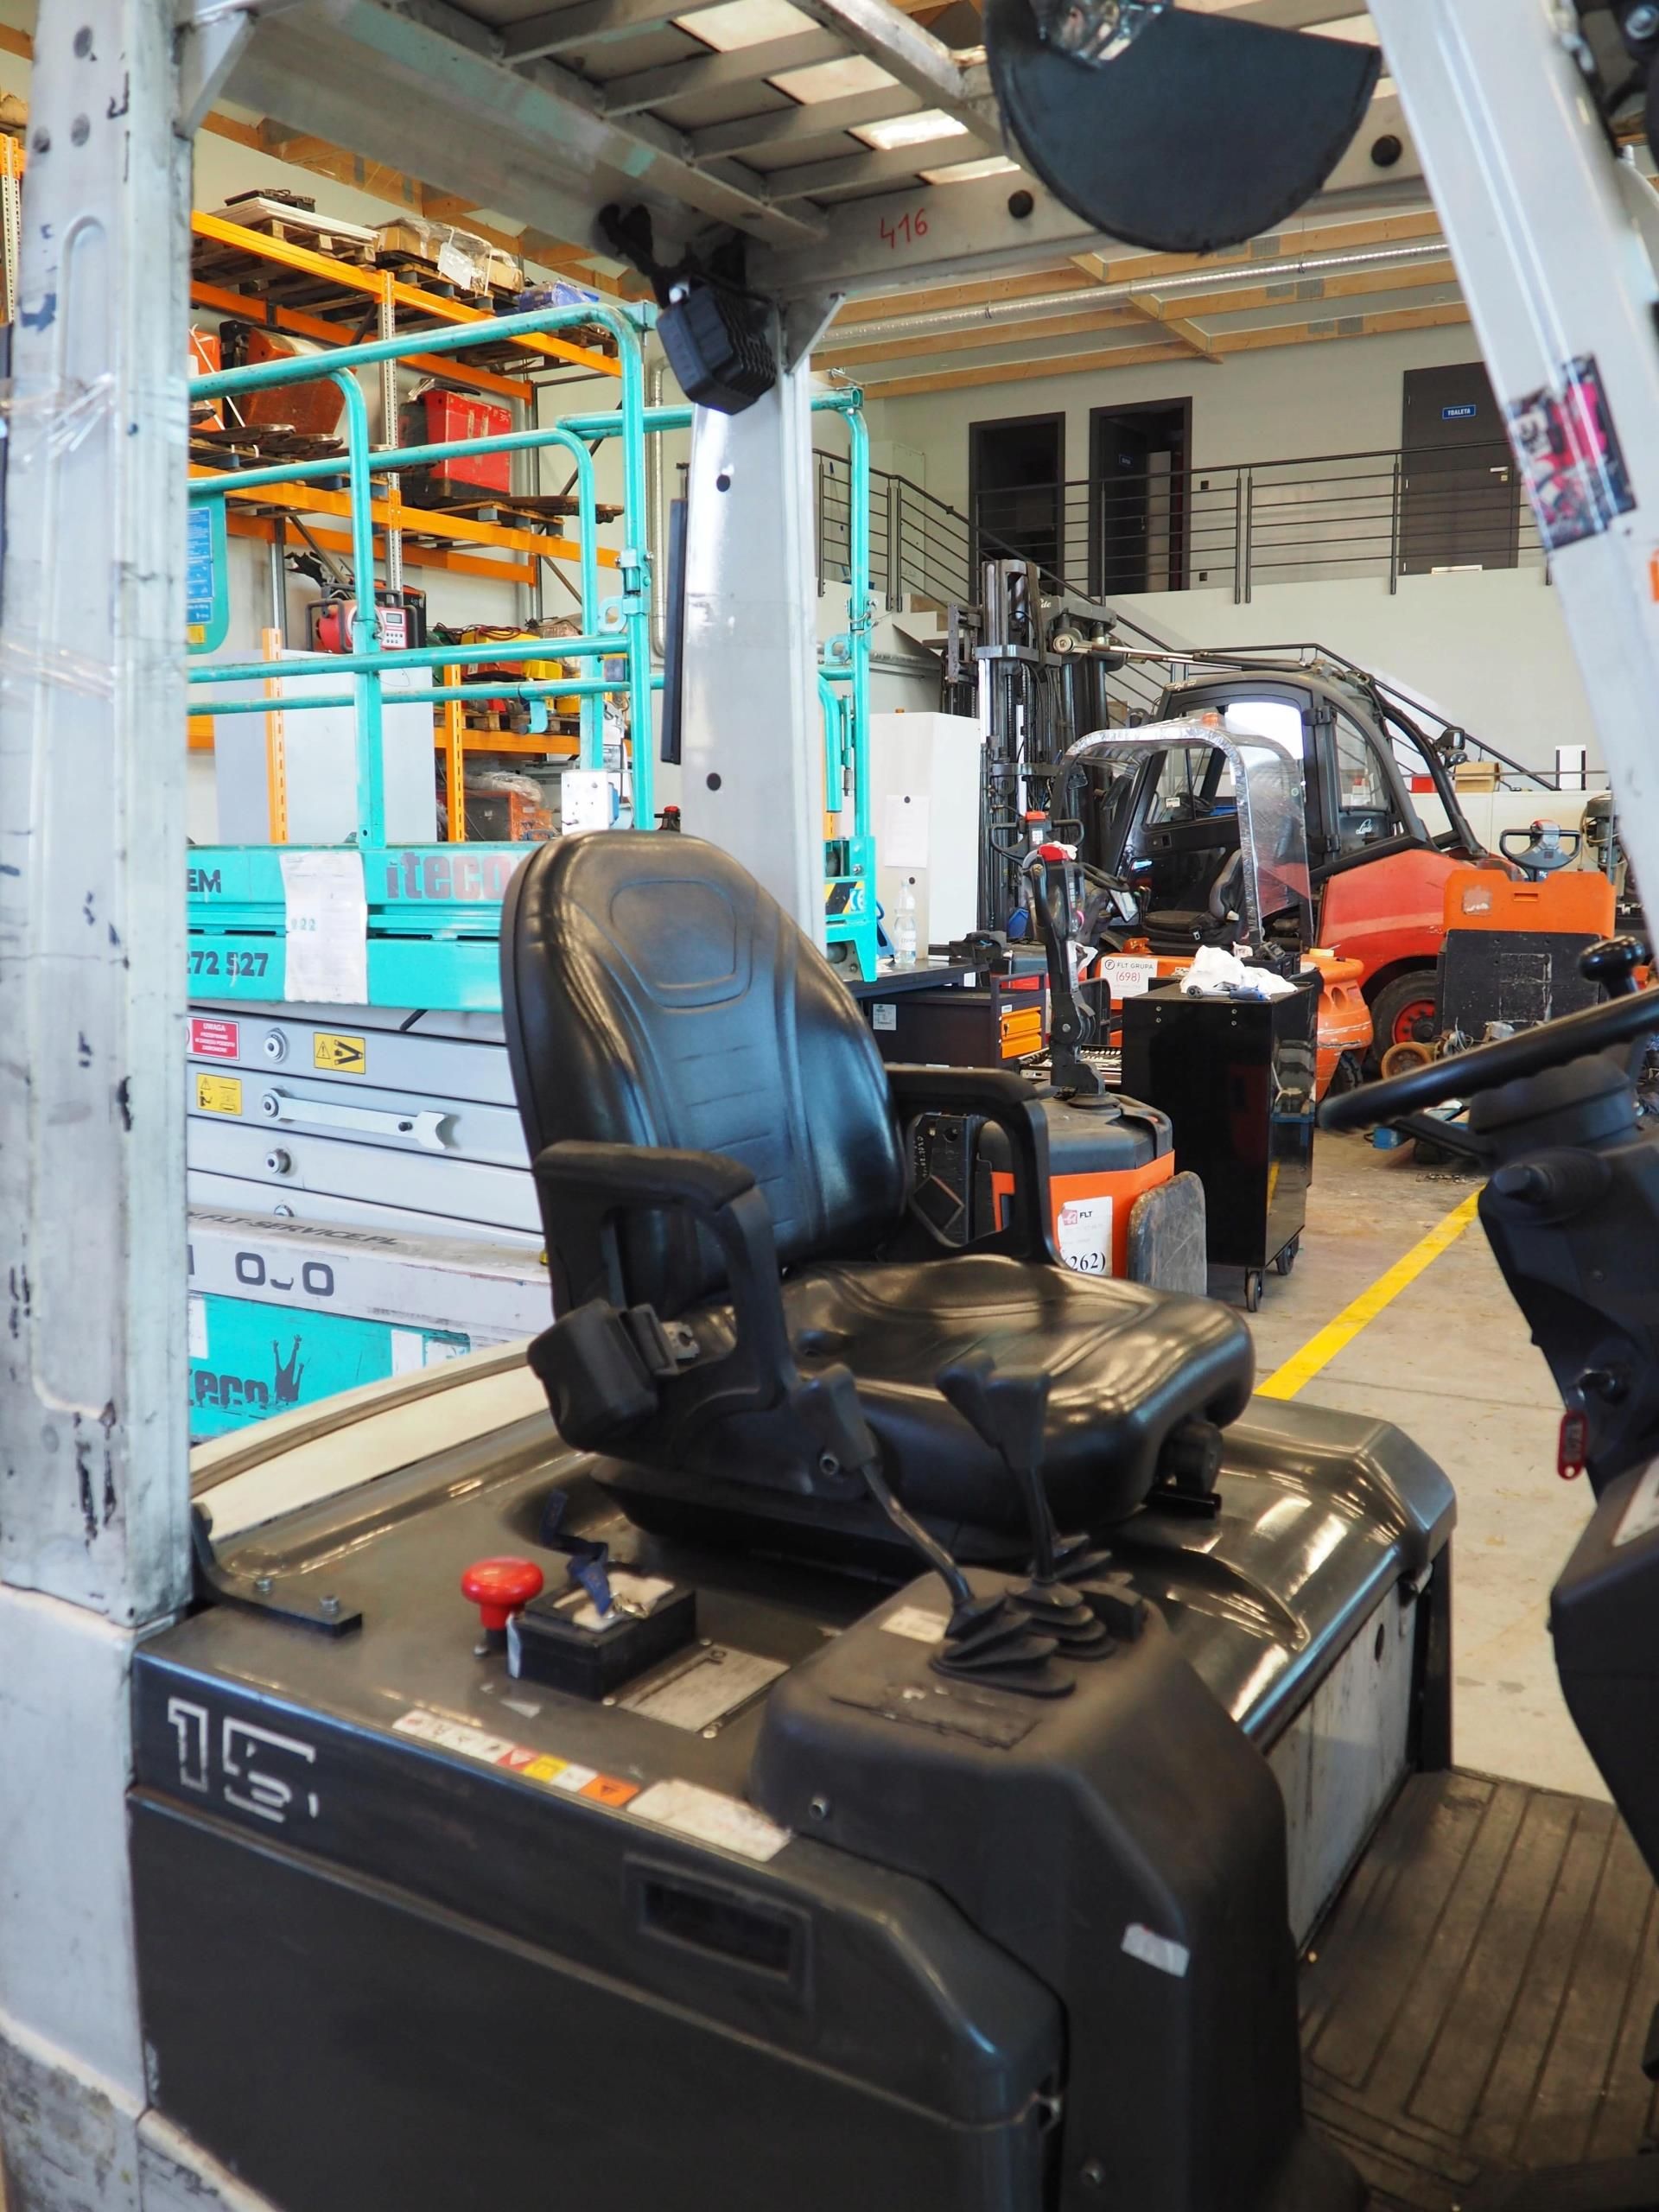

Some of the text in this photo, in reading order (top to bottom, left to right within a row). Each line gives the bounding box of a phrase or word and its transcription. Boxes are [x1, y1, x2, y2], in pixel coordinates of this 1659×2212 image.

[880, 207, 928, 249] 416
[226, 952, 269, 977] 527
[1116, 971, 1141, 982] (698)
[203, 1022, 226, 1032] UWAGA
[1079, 1211, 1093, 1219] FLT
